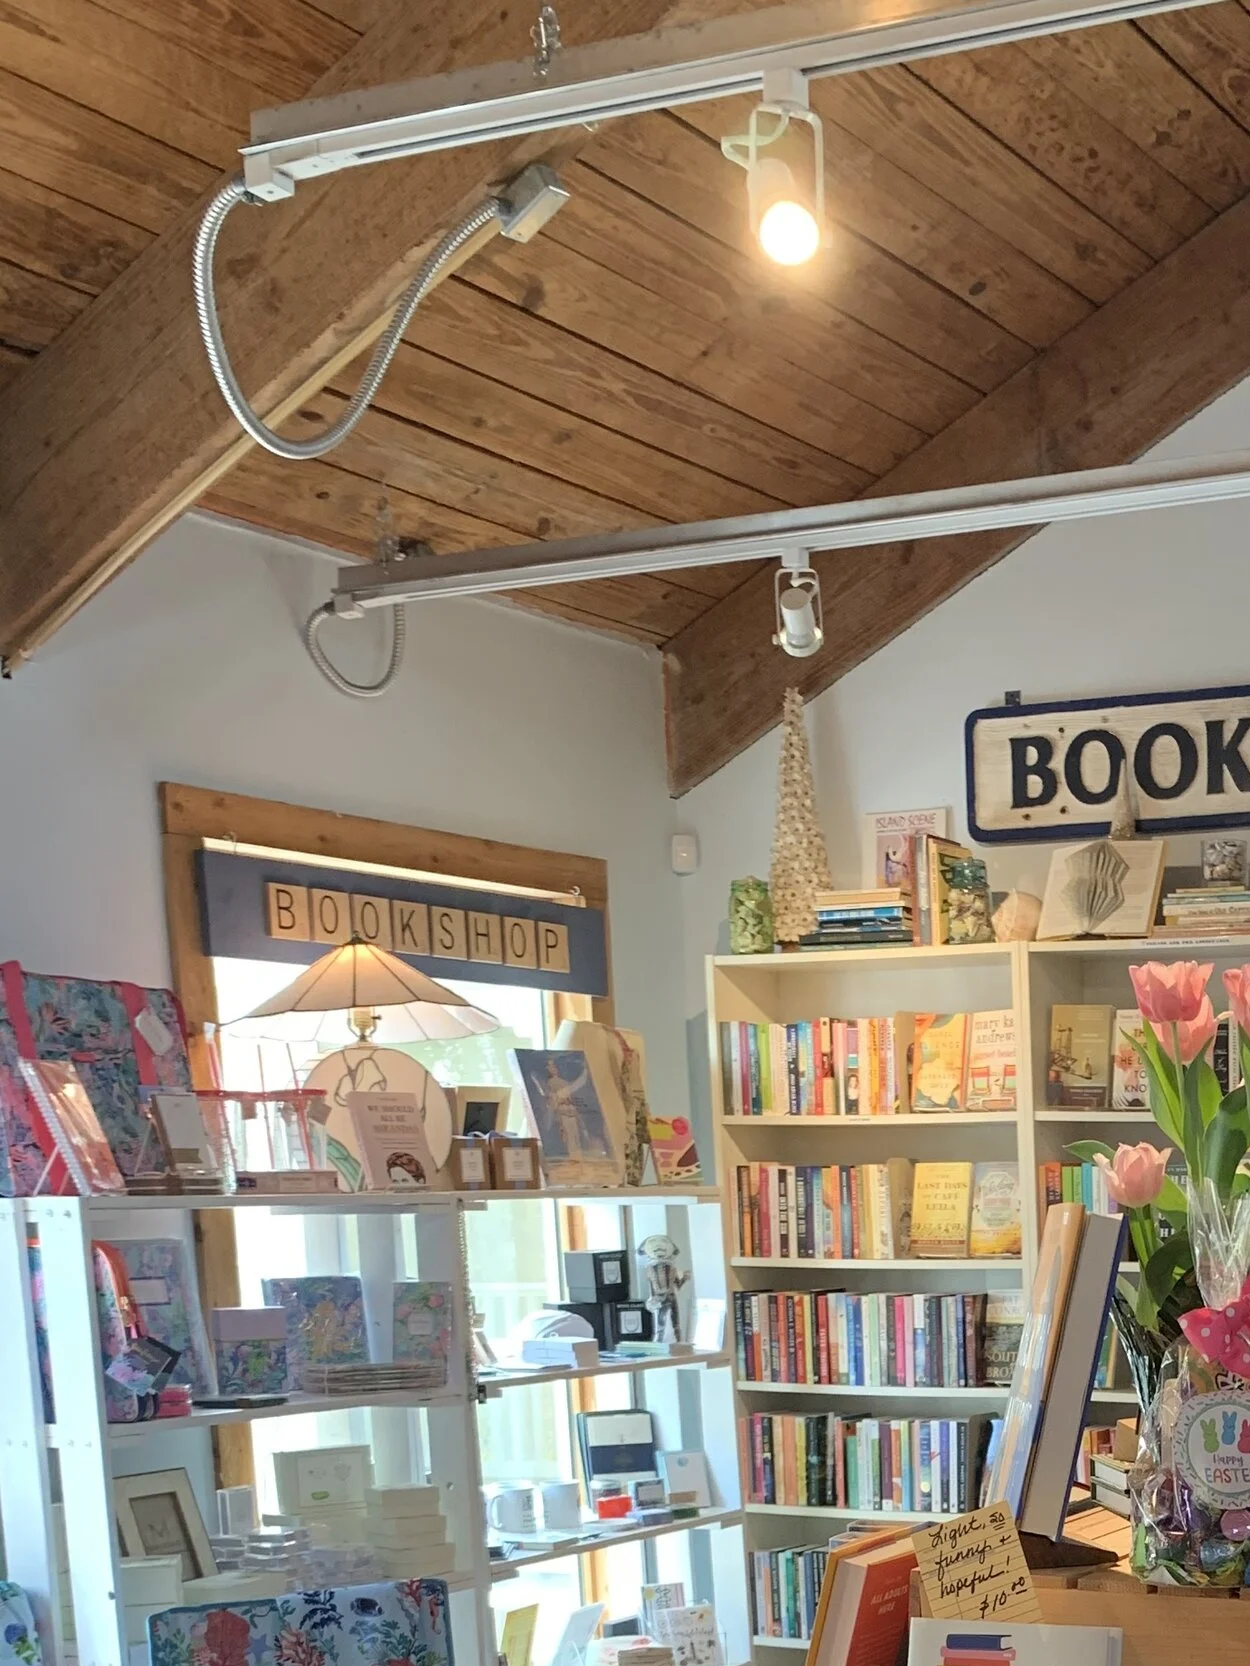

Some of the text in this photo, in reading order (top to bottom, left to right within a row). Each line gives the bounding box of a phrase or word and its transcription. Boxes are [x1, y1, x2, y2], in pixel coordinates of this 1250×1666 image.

[277, 888, 560, 964] BOOKSHOP
[1124, 1084, 1148, 1093] KNO
[1213, 1453, 1244, 1467] Happy
[929, 1516, 987, 1549] Light,
[935, 1540, 992, 1580] funny
[941, 1556, 1010, 1599] hopeful!
